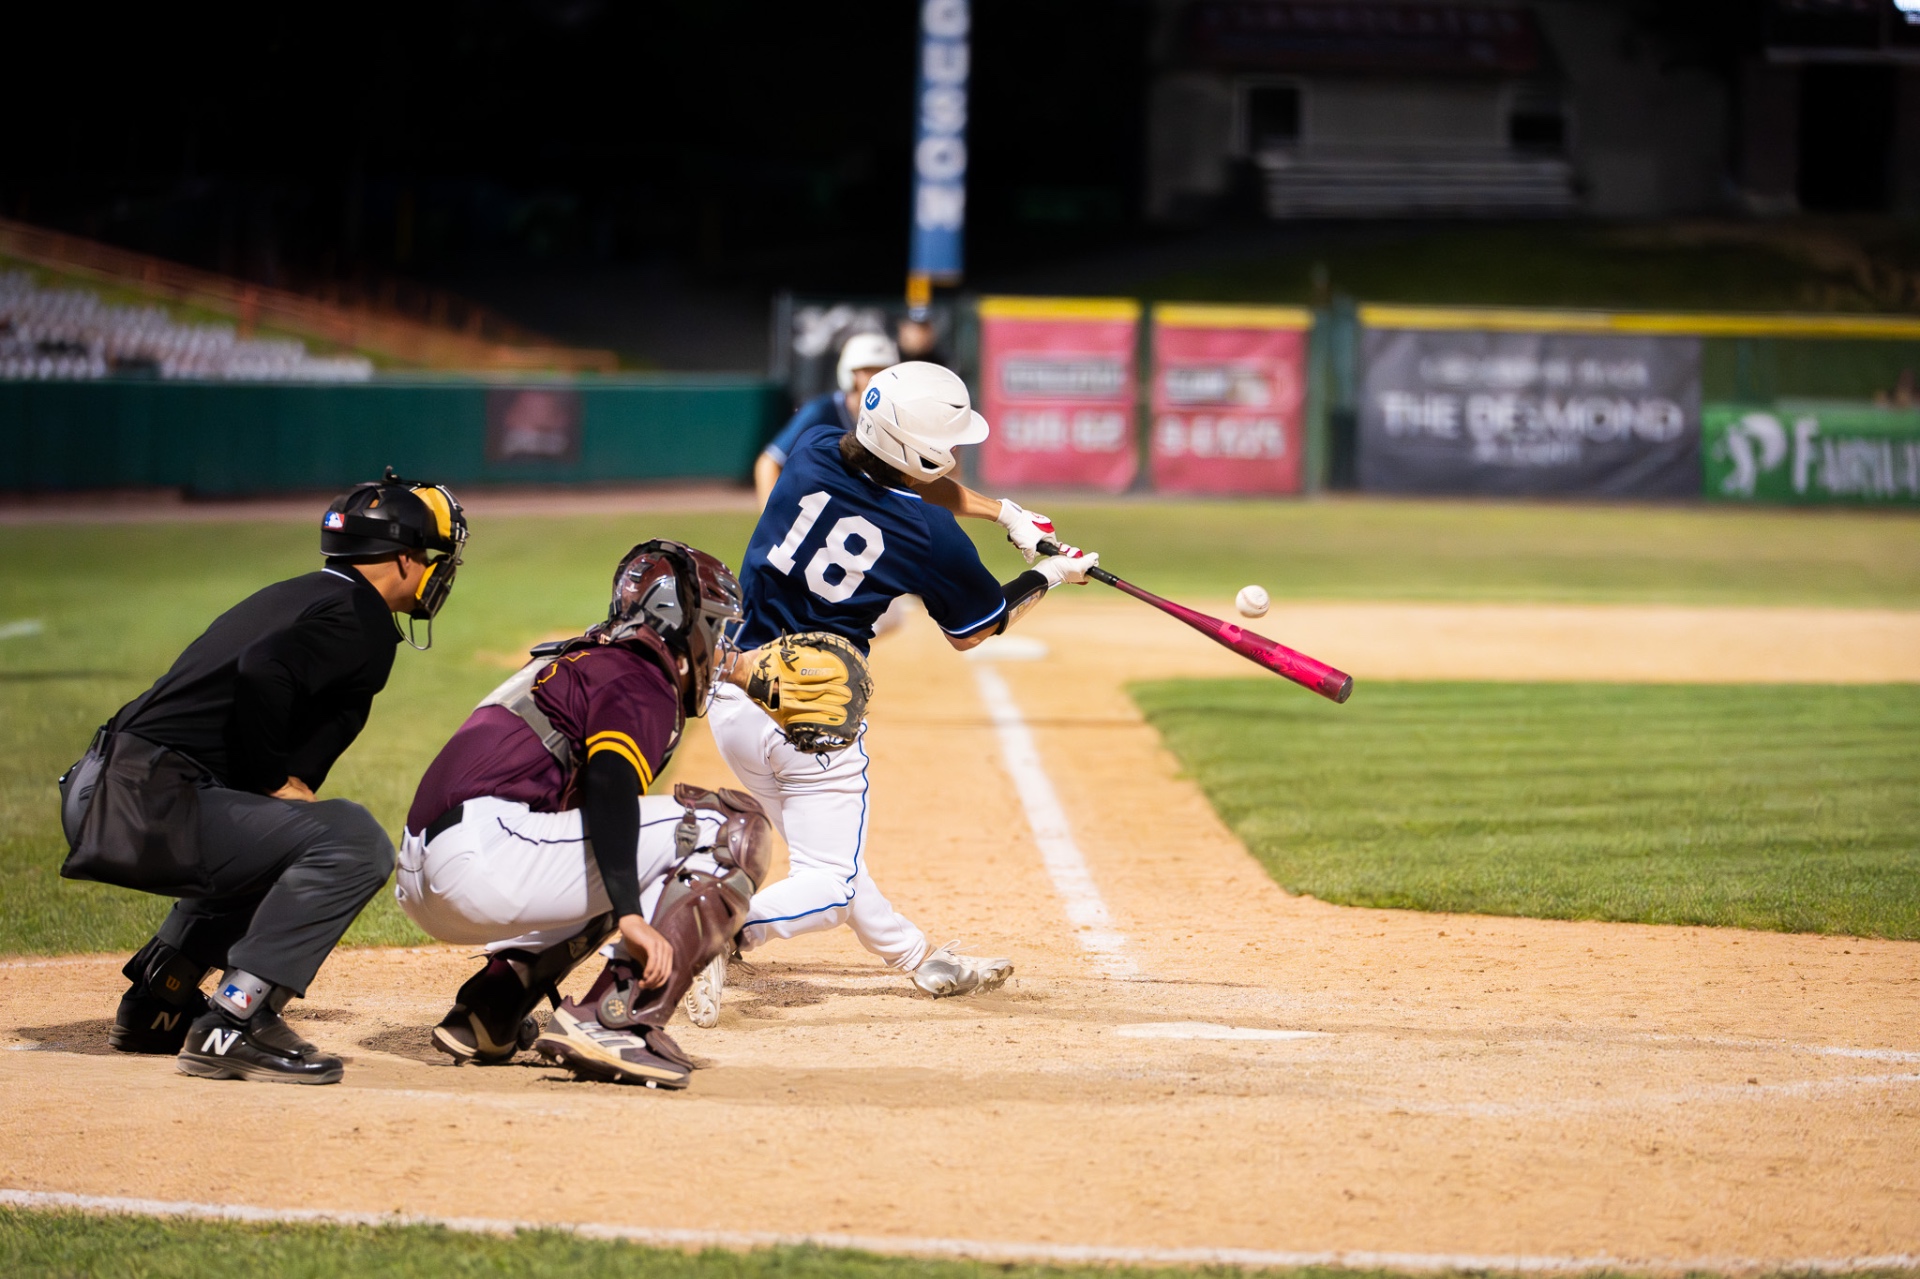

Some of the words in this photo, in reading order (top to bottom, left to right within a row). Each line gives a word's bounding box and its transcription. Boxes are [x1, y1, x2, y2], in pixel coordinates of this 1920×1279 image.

[1383, 391, 1460, 439] THE
[1465, 394, 1684, 443] DESMOND
[766, 490, 885, 603] 18
[151, 1011, 182, 1032] N
[201, 1028, 243, 1056] N
